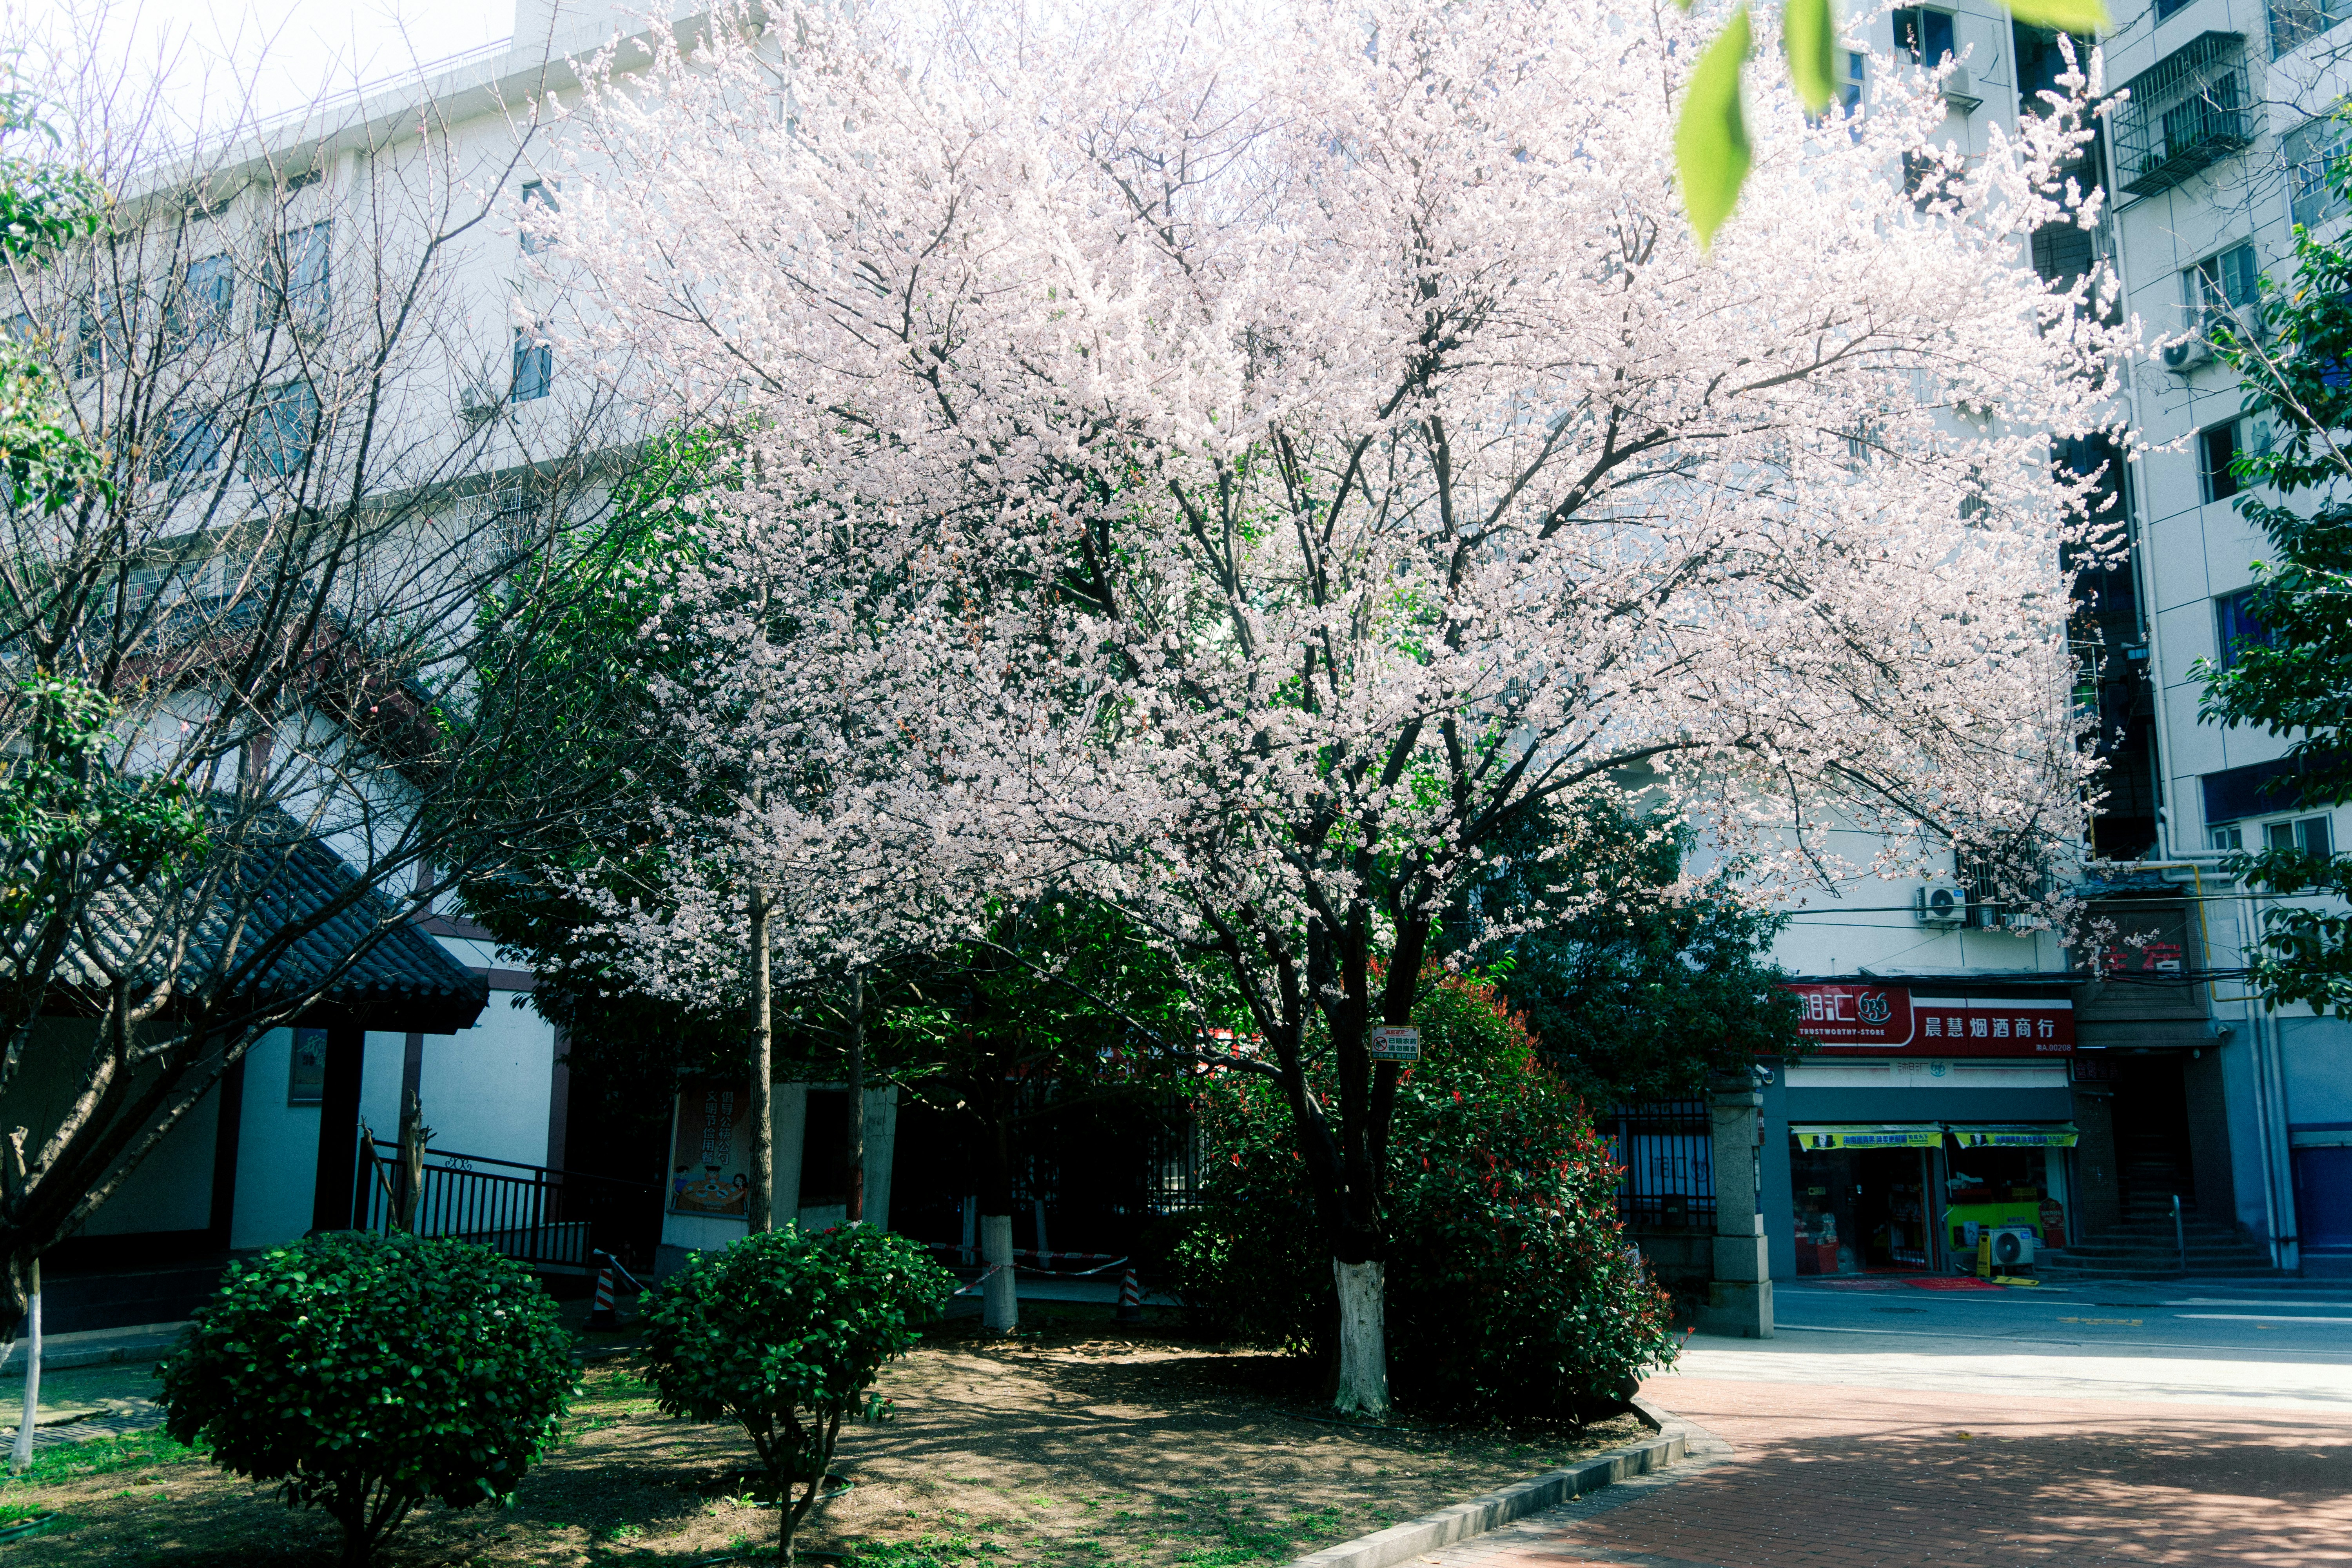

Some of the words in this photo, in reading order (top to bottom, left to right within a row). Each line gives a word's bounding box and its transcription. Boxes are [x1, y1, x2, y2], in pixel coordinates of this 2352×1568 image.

[1925, 1016, 2054, 1038] 晨慧烟酒商行
[701, 1090, 718, 1164] 文明节俭用餐
[717, 1091, 734, 1165] 倡导公筷公勺
